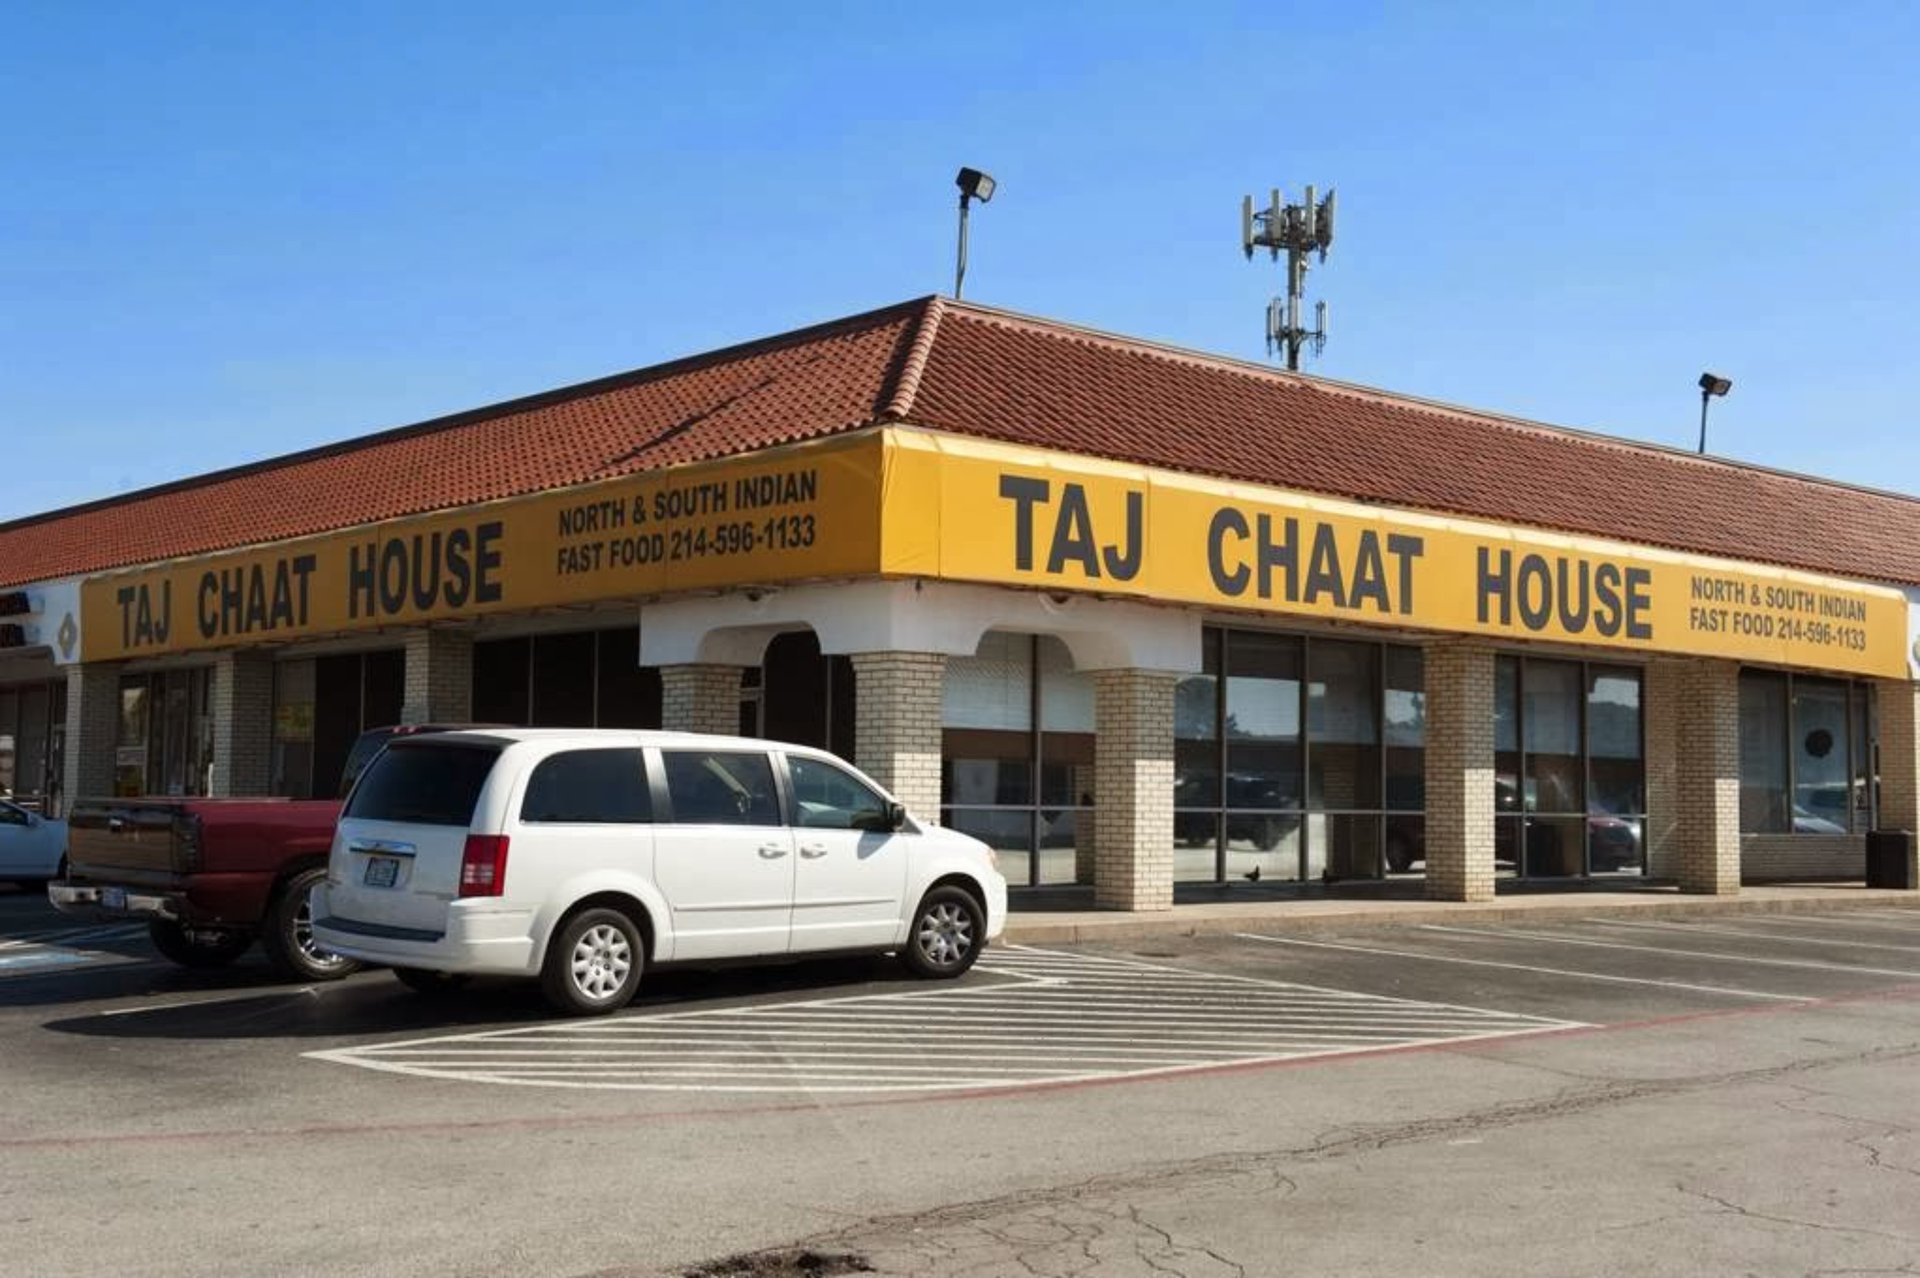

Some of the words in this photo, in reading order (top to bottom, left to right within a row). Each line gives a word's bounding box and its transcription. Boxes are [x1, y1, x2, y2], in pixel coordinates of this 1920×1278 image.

[559, 500, 625, 537] NORTH
[633, 496, 646, 525] &
[654, 480, 727, 521] SOUTH
[735, 470, 817, 509] INDIAN
[557, 543, 603, 575] FAST
[609, 533, 664, 568] FOOD
[671, 514, 816, 561] 214-596-1133
[1000, 474, 1143, 581] TAJ
[1208, 507, 1424, 615] CHAAT
[1477, 546, 1653, 640] HOUSE
[118, 579, 171, 648] TAJ
[197, 554, 316, 639] CHAAT
[349, 521, 503, 619] HOUSE
[1690, 575, 1745, 605] NORTH
[1750, 585, 1761, 606] &
[1765, 586, 1815, 614] SOUTH
[1819, 594, 1867, 623] INDIAN
[1690, 607, 1727, 633] FAST
[1733, 612, 1774, 637] FOOD
[1777, 615, 1867, 652] 214-596-1133
